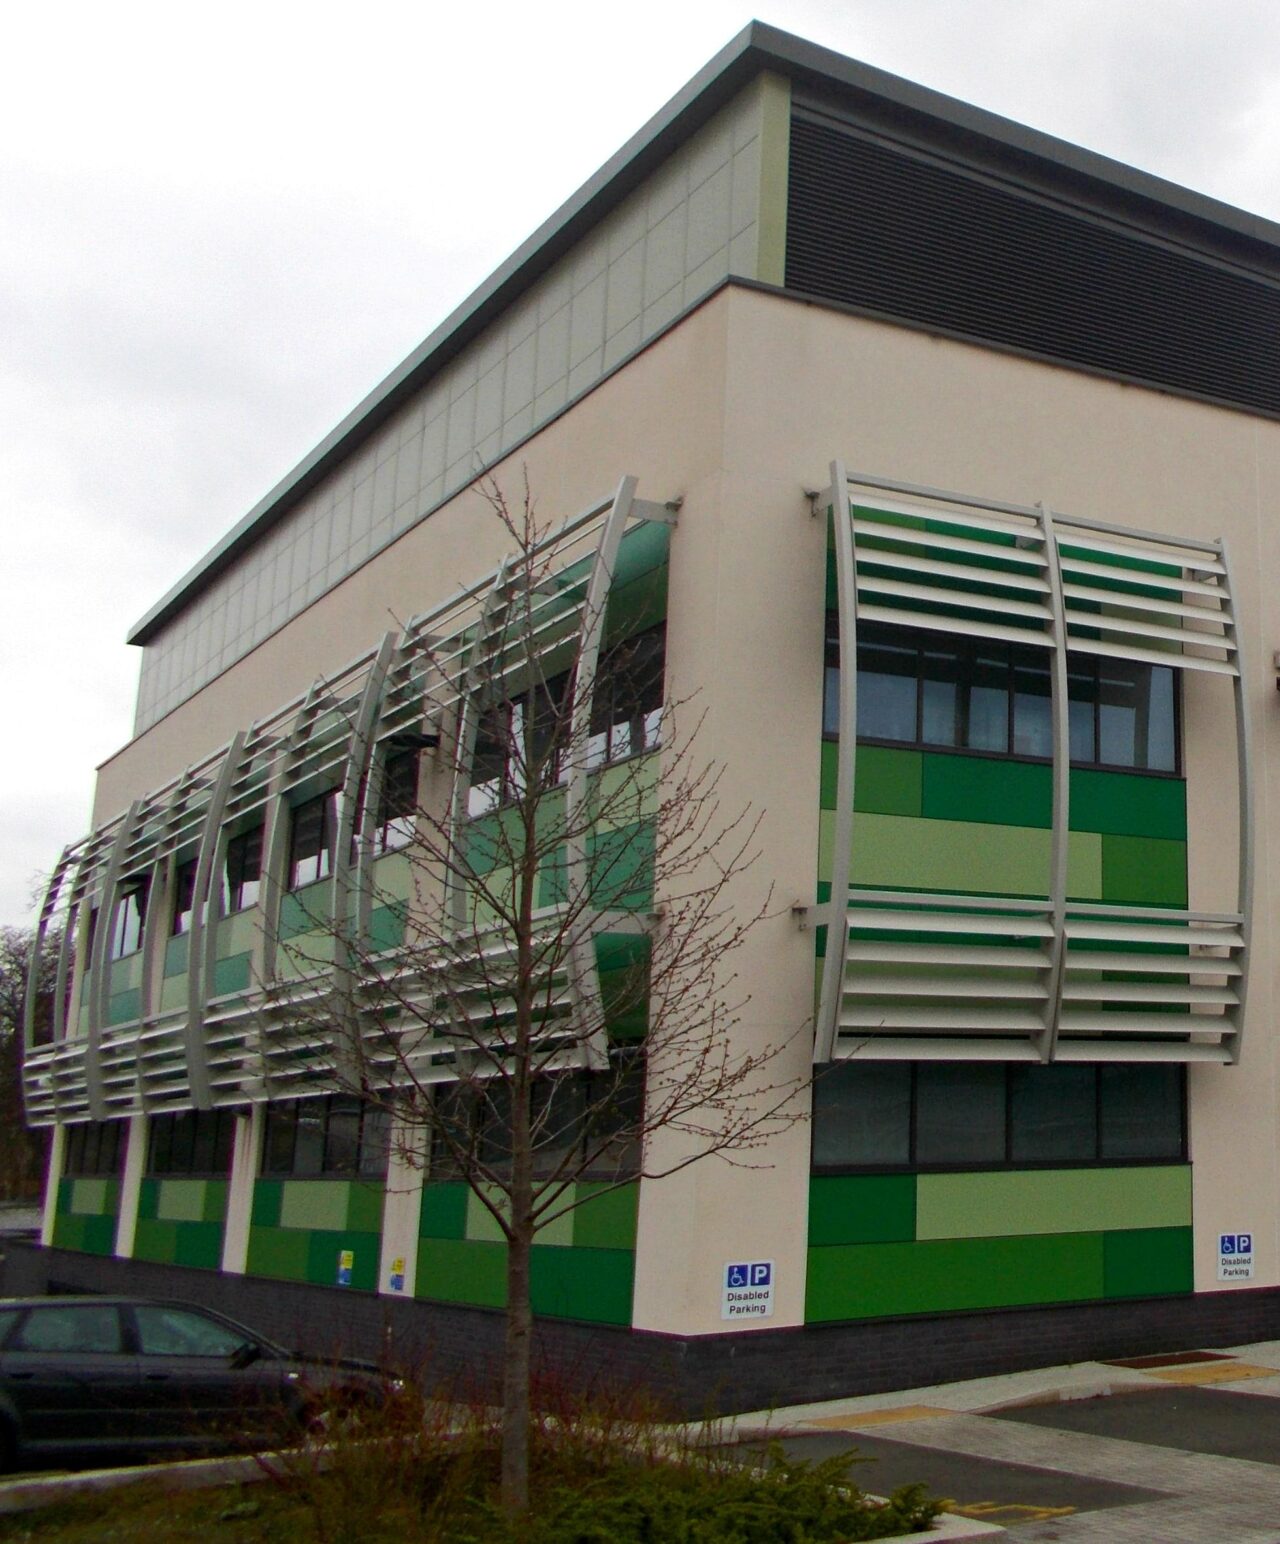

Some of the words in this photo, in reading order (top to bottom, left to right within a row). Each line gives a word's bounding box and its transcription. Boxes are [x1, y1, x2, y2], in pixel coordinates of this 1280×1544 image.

[1221, 1257, 1251, 1265] Disabled
[1223, 1268, 1249, 1276] Parking
[727, 1291, 770, 1302] Disabled
[729, 1304, 766, 1314] Parking
